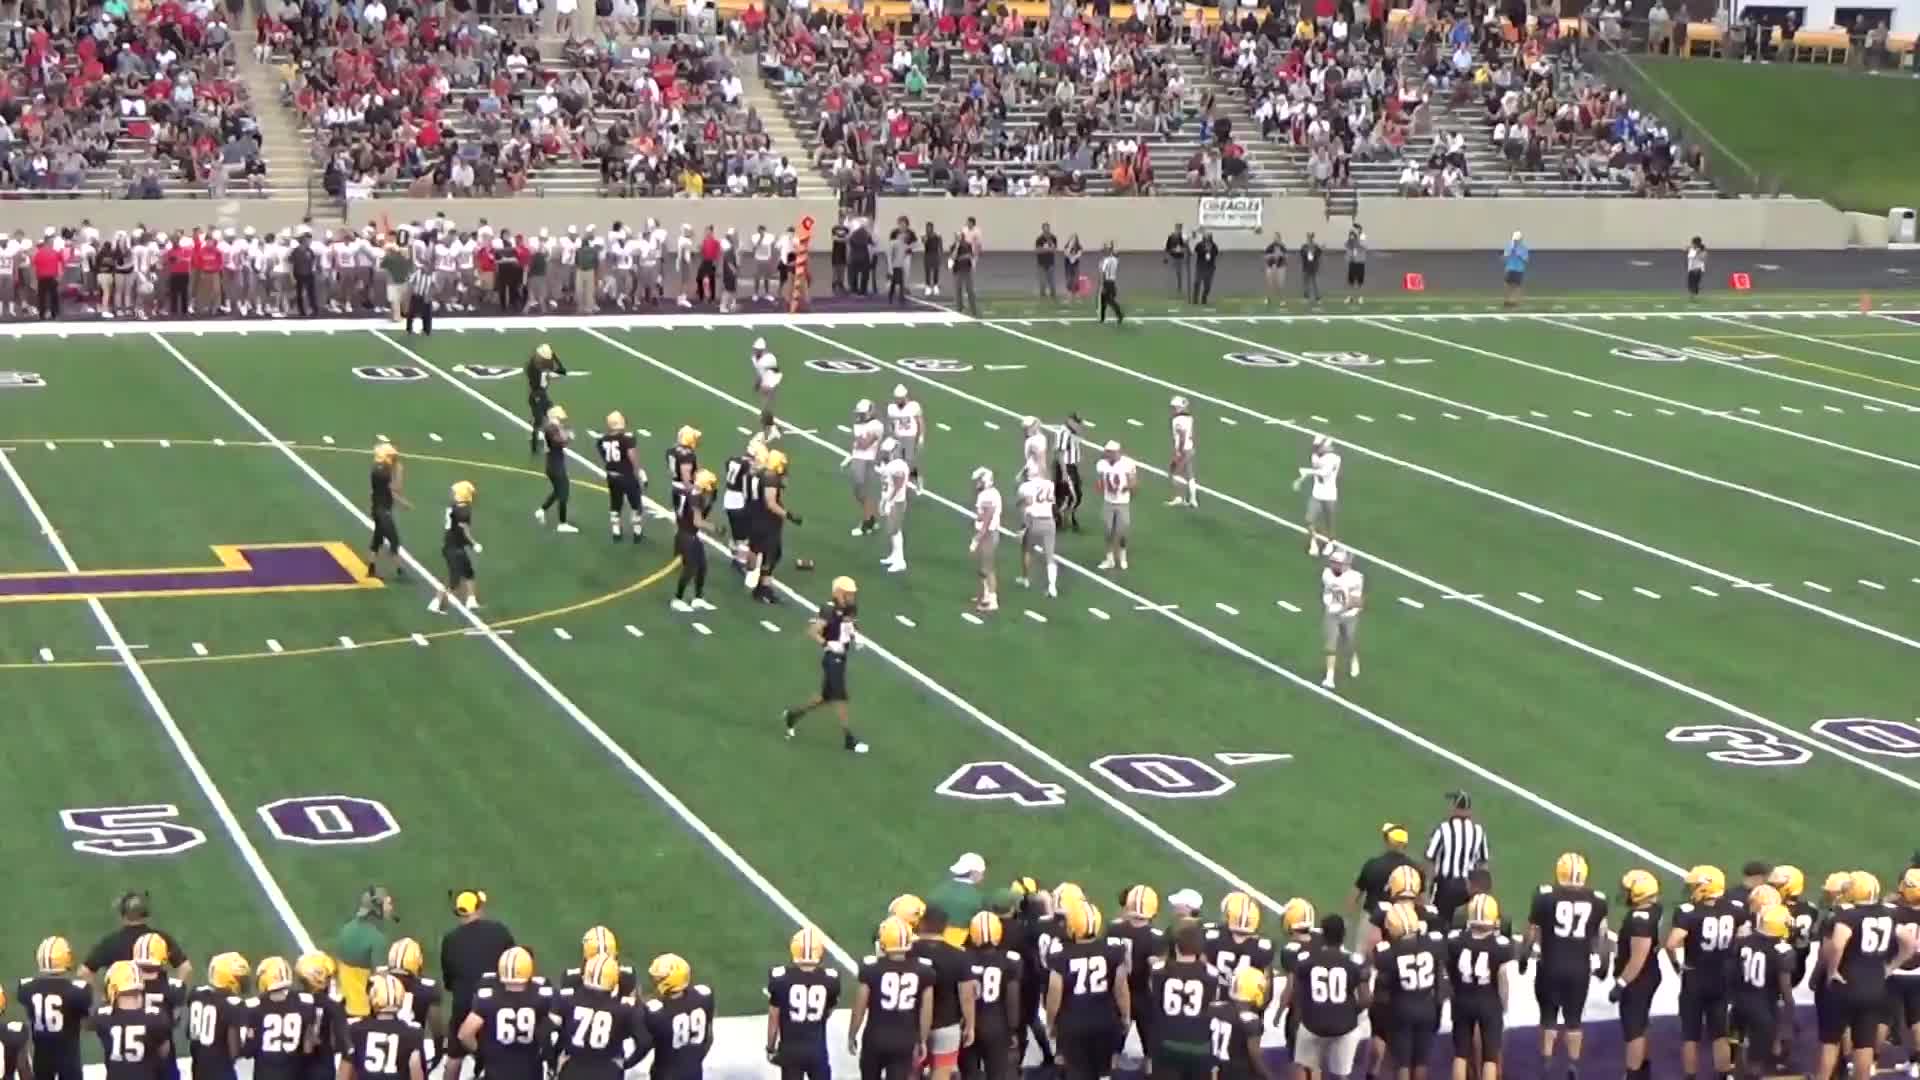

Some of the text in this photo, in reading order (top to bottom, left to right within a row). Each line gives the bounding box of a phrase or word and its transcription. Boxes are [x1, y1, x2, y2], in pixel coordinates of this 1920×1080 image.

[1554, 901, 1592, 938] 97
[1700, 915, 1734, 951] 98
[1862, 917, 1892, 951] 67
[1069, 956, 1107, 994] 72
[1310, 966, 1347, 1003] 60
[1397, 951, 1435, 991] 52
[1458, 948, 1491, 985] 44
[788, 984, 827, 1022] 99
[880, 972, 919, 1010] 92
[1163, 978, 1204, 1016] 63
[32, 992, 63, 1032] 16
[189, 1001, 217, 1046] 80
[496, 1007, 536, 1045] 69
[572, 1006, 612, 1049] 78
[672, 1007, 707, 1050] 89
[110, 1025, 146, 1062] 15
[263, 1012, 301, 1052] 29
[364, 1031, 399, 1074] 51
